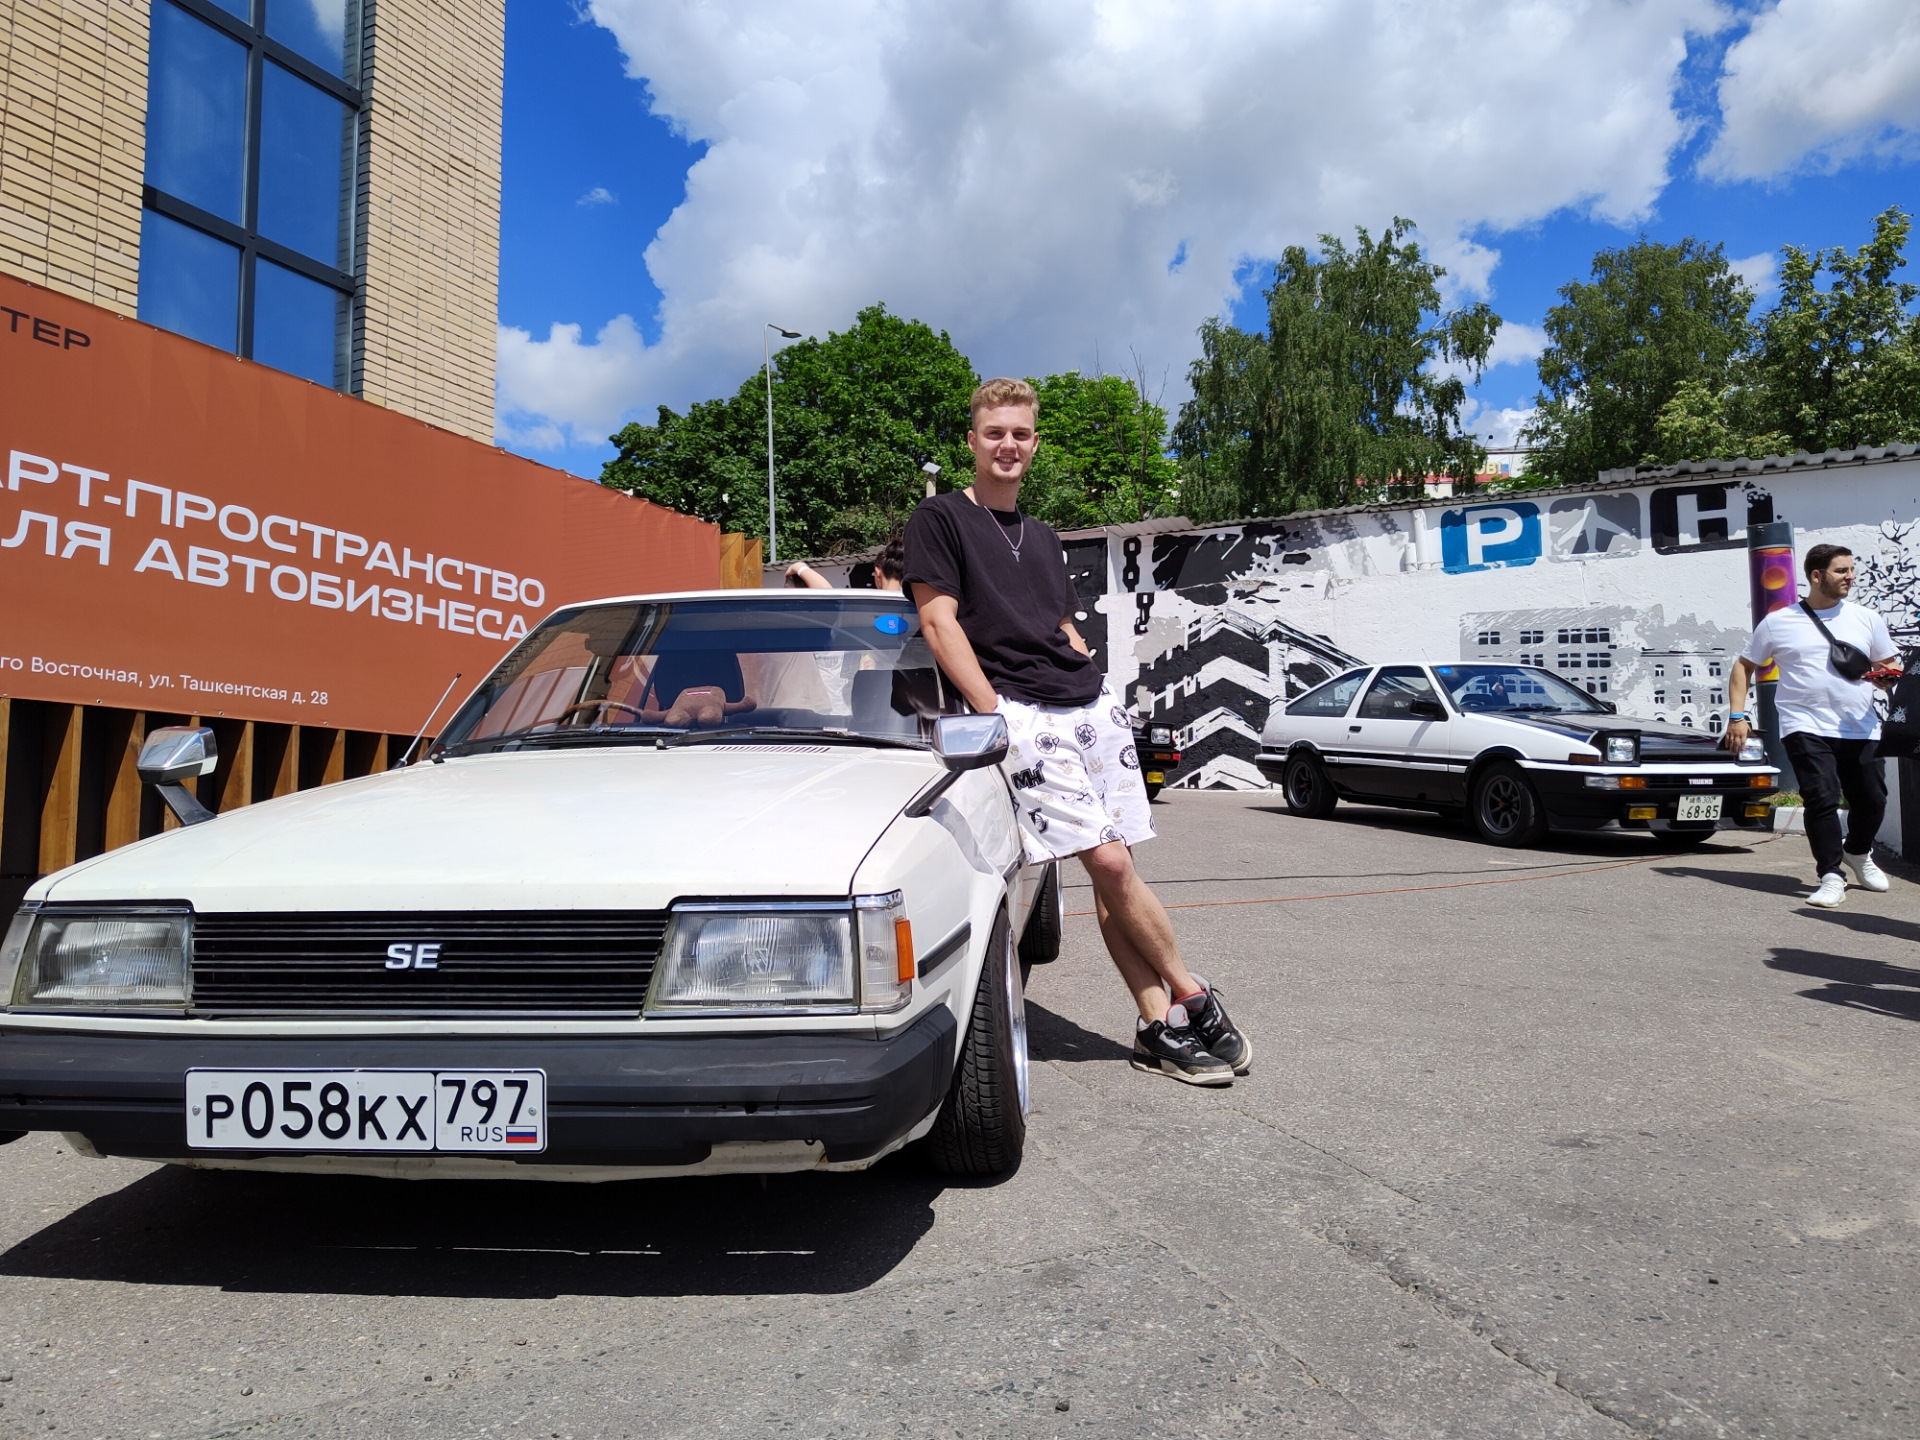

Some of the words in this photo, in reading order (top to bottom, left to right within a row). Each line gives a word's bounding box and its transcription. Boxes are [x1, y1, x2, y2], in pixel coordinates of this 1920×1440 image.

[0, 449, 546, 608] РТ-ПРОСТРАНСТВО
[1465, 507, 1524, 566] P
[133, 537, 529, 642] АВТОБИЗНЕСА
[30, 656, 144, 687] Восточная,
[148, 673, 175, 690] ул.
[179, 674, 288, 702] Ташкентская
[291, 691, 306, 704] д.
[310, 690, 329, 706] 28
[1686, 805, 1719, 819] 68-85
[385, 943, 441, 969] SE
[440, 1079, 529, 1125] 797
[461, 1125, 503, 1143] RUS
